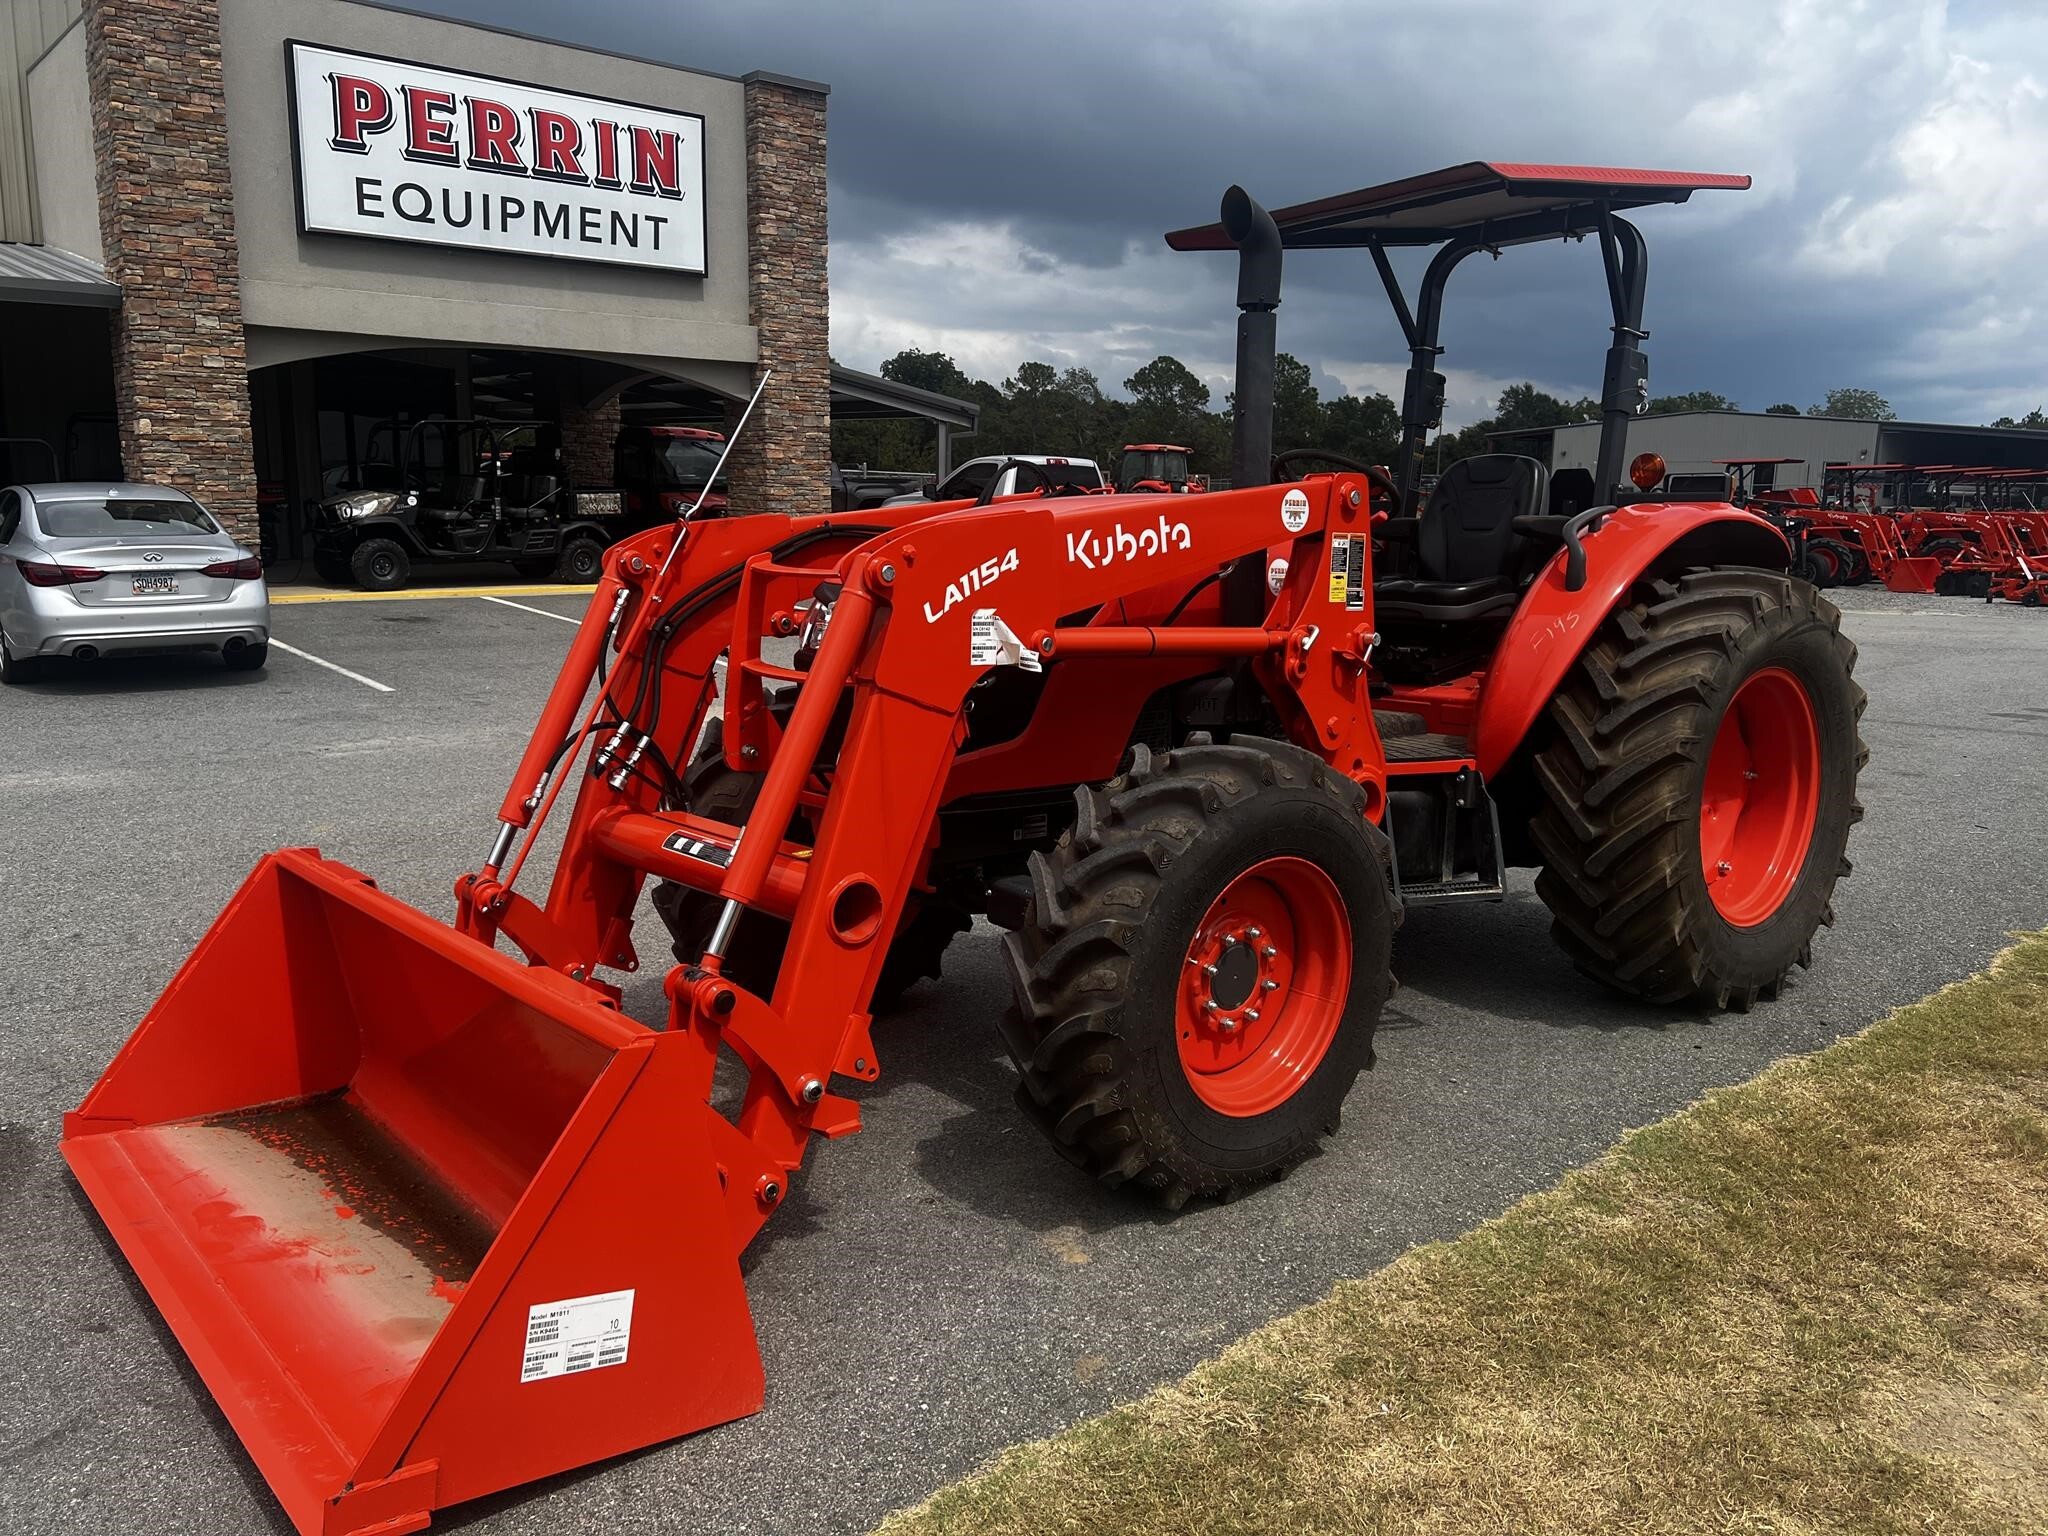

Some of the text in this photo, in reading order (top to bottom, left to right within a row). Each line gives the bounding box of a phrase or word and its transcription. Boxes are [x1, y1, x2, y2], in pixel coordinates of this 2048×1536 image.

[323, 72, 685, 200] PERRIN
[355, 176, 668, 251] EQUIPMENT
[1066, 515, 1191, 569] Kubota
[923, 548, 1019, 624] LA1154
[531, 1313, 548, 1321] Model
[610, 1318, 619, 1330] 10
